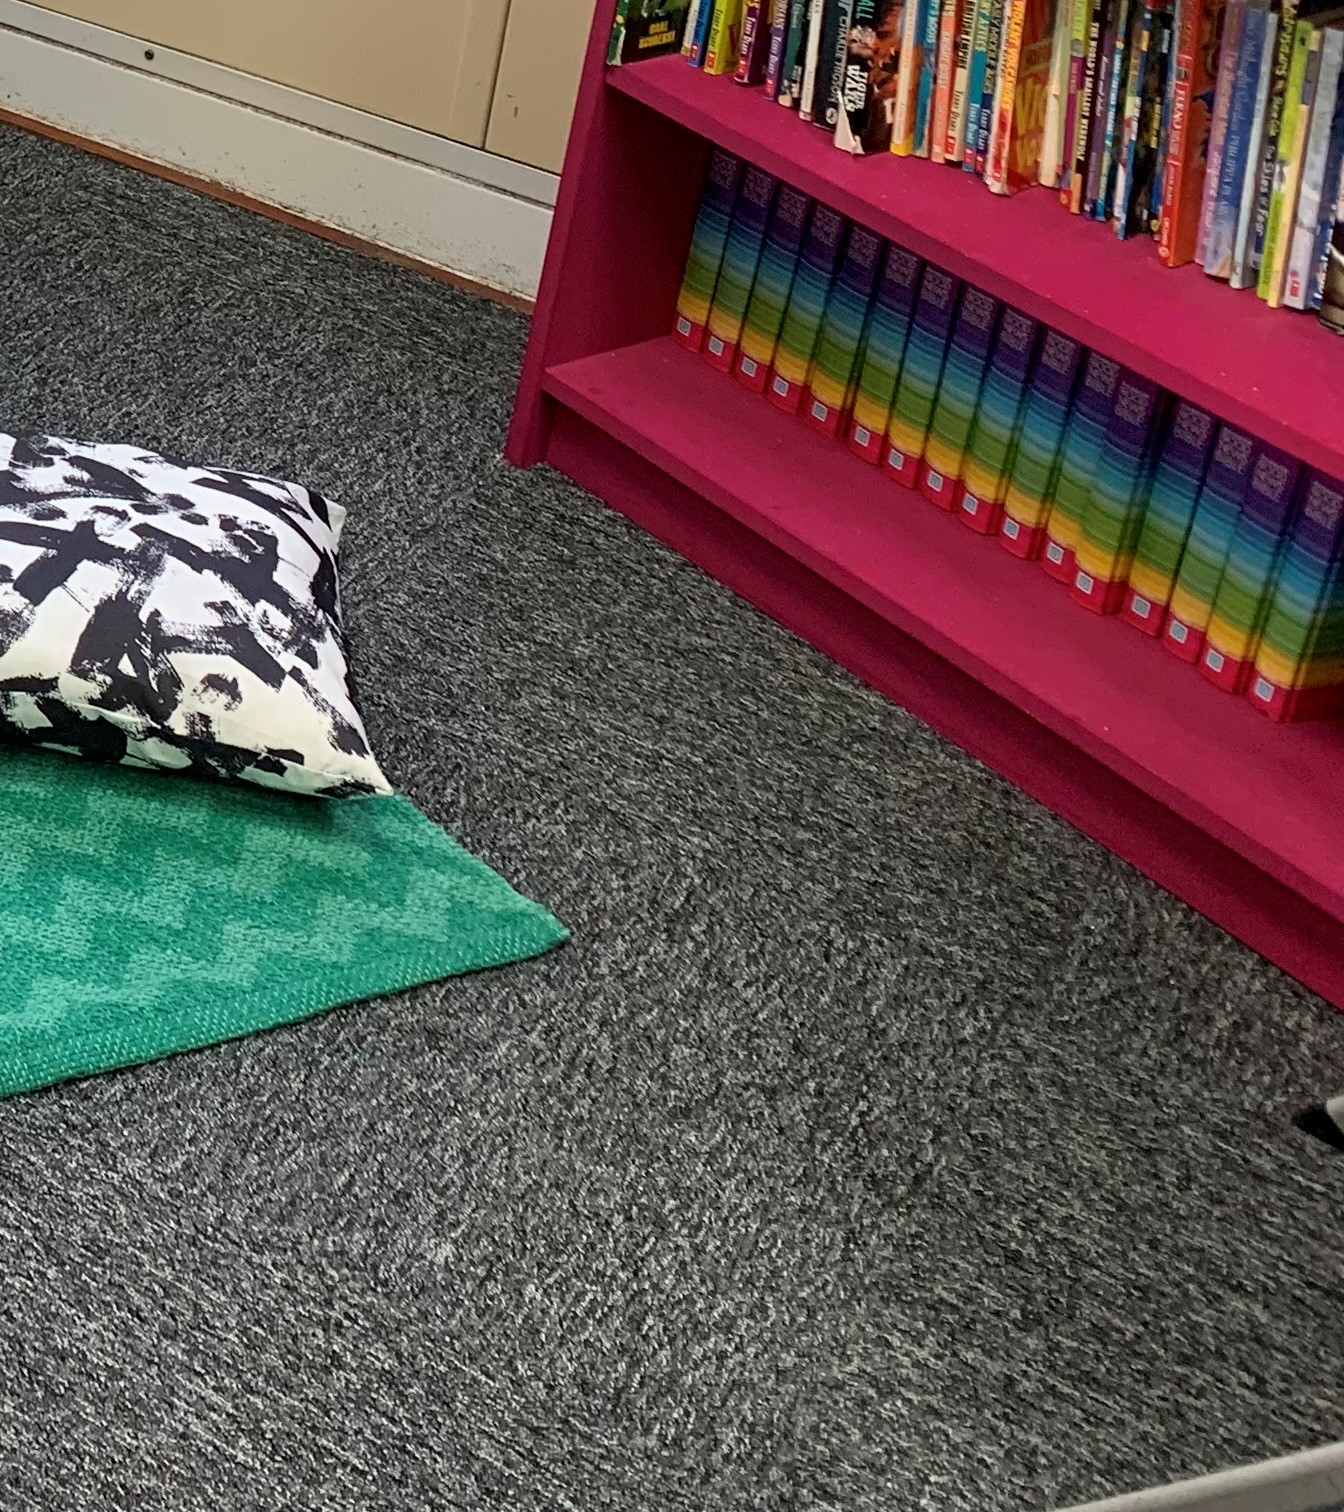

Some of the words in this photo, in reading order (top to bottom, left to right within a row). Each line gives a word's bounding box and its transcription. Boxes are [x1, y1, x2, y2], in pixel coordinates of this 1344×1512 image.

[962, 0, 977, 37] BRITISH
[957, 36, 972, 70] EMPIRE
[1082, 76, 1094, 116] SMALLEST
